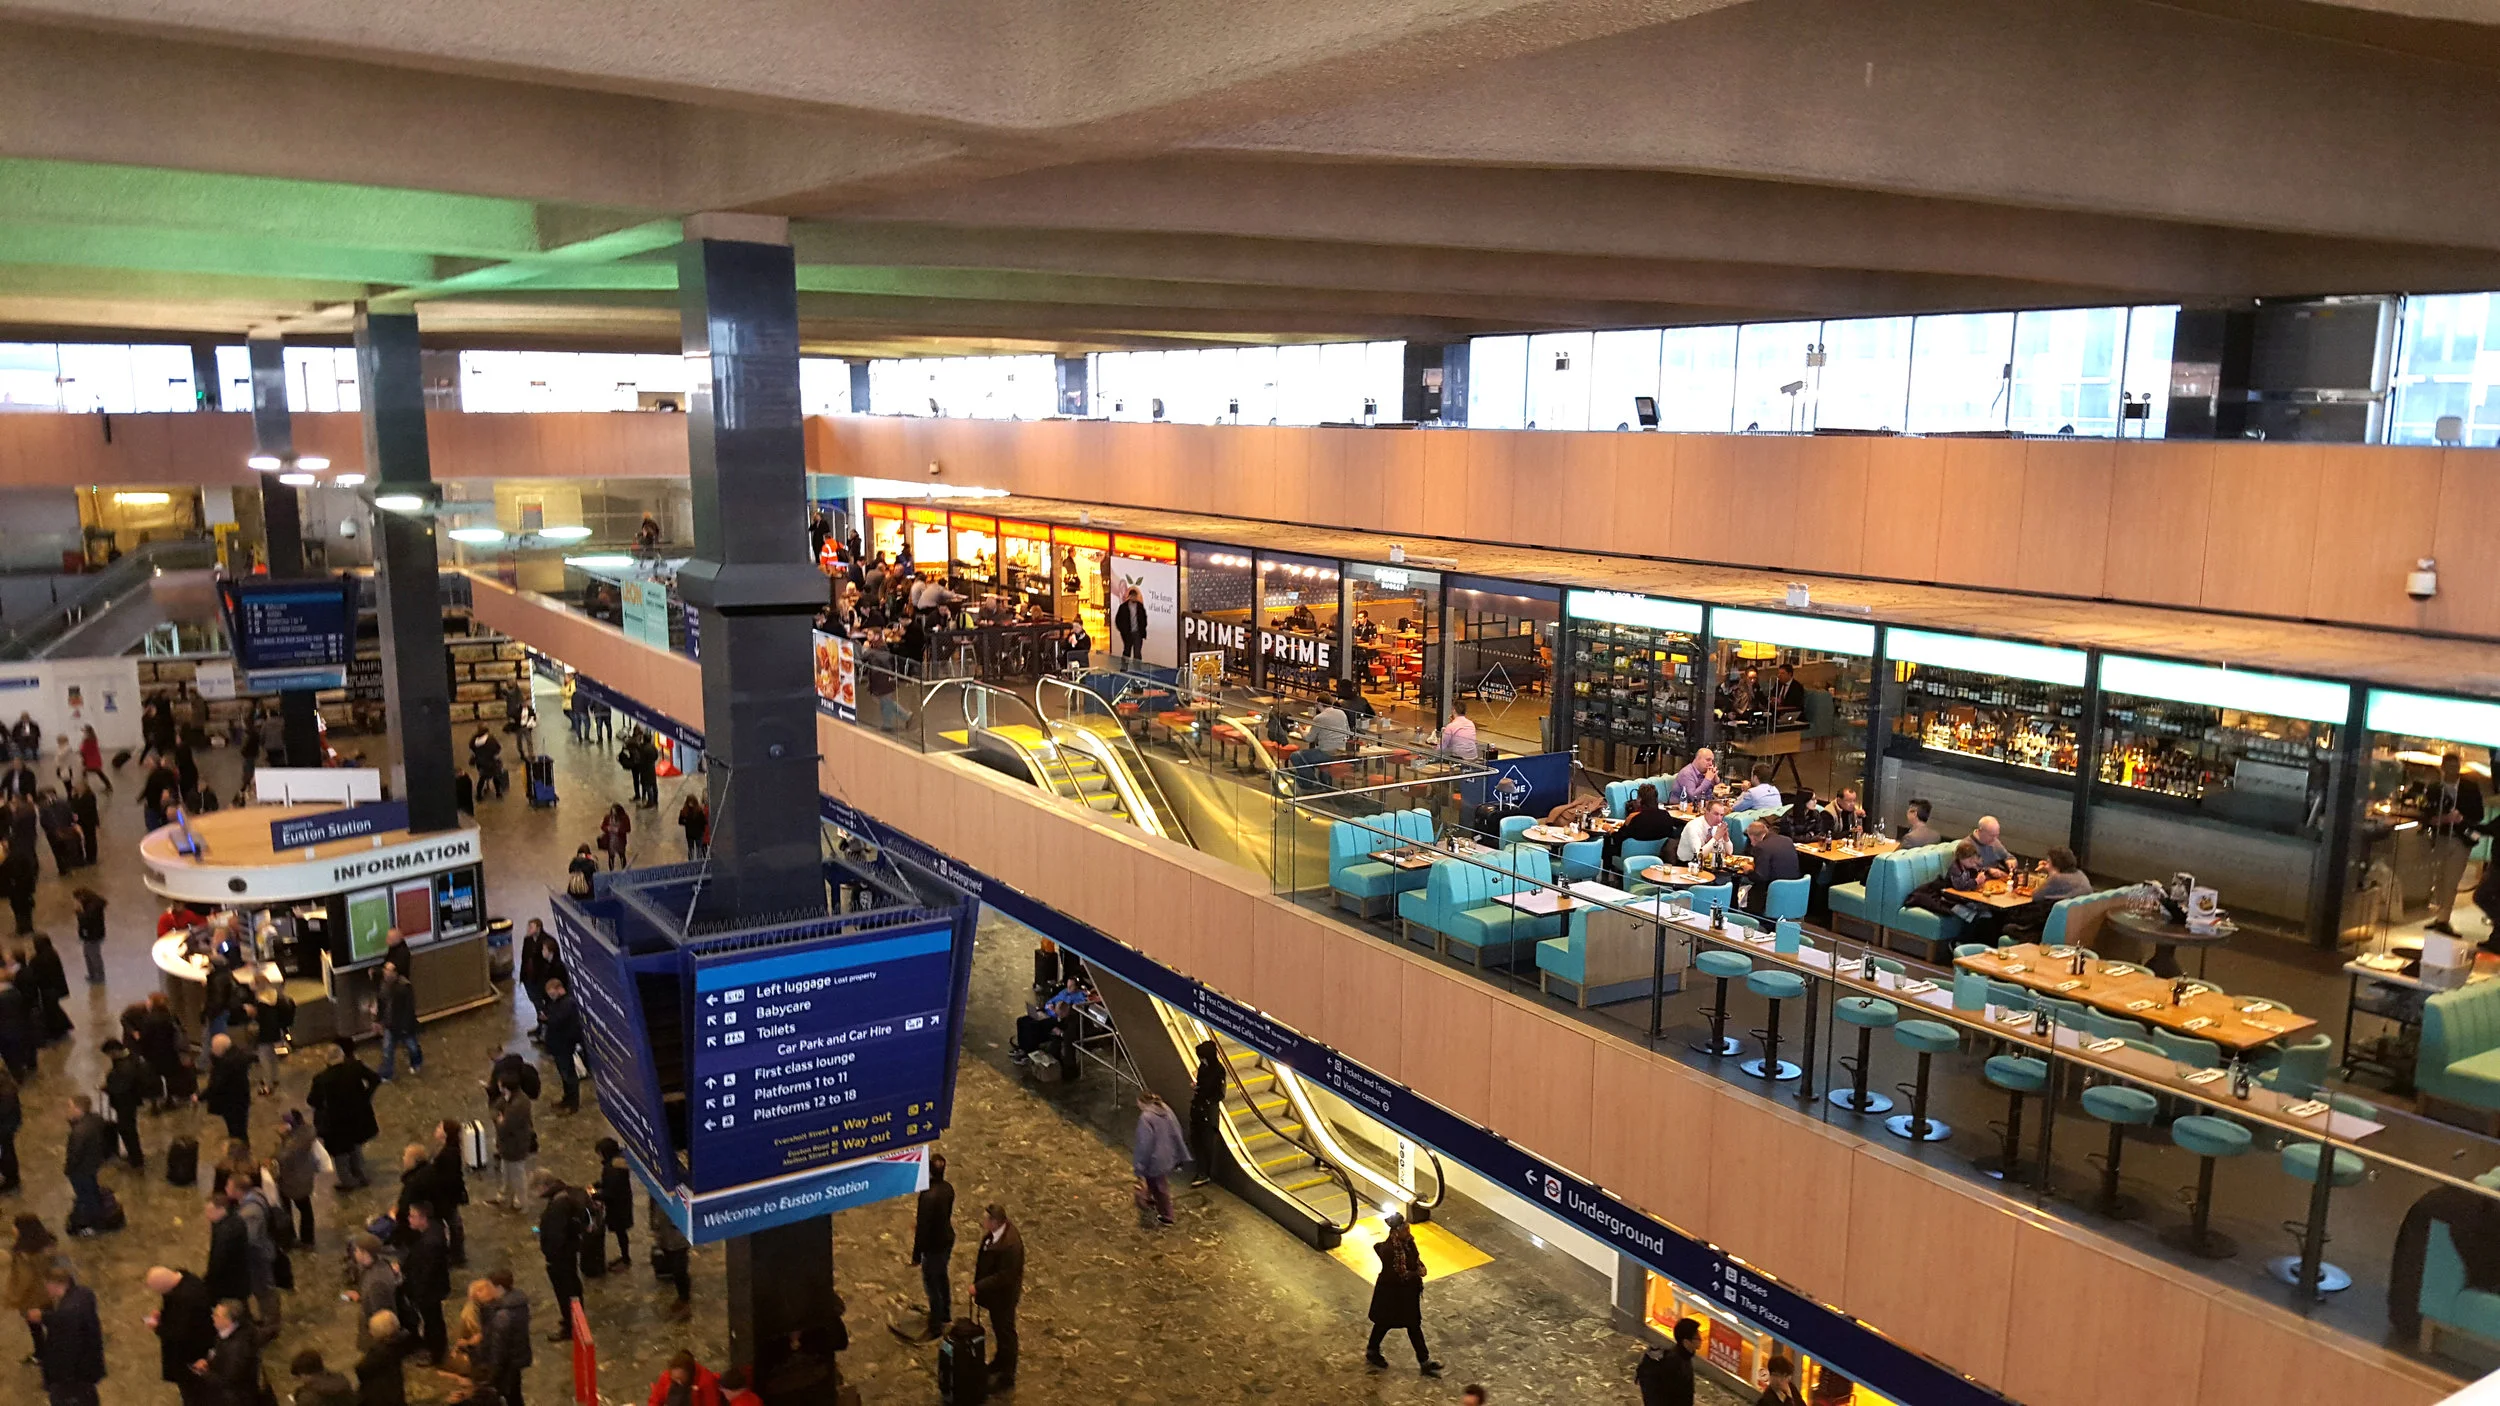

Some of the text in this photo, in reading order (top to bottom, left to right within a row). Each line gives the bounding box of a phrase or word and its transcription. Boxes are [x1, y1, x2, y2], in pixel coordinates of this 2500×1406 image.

[1184, 616, 1246, 650] PRIME
[1261, 631, 1330, 668] PRIME
[283, 820, 372, 846] Euston Station
[333, 840, 470, 883] INFORMATION
[756, 984, 781, 999] Left
[784, 975, 832, 994] luggage
[849, 970, 877, 984] property
[756, 1000, 812, 1019] Babycare
[1206, 994, 1216, 1006] First
[1216, 999, 1229, 1012] Class
[1229, 1005, 1246, 1022] lounge
[1206, 1008, 1232, 1029] Restaurants
[1231, 1022, 1241, 1034] and
[757, 1022, 796, 1039] Toilets
[777, 1024, 892, 1056] Car Park and Car Hire
[754, 1052, 856, 1080] First class lounge
[754, 1072, 848, 1101] Platforms 1 to 11
[1342, 1079, 1381, 1108] Visitor centre
[1344, 1064, 1392, 1098] Tickets and Trains
[753, 1089, 857, 1121] Platforms 12 to 18
[808, 1128, 830, 1138] Street
[842, 1116, 869, 1132] Way
[871, 1111, 892, 1124] out
[842, 1137, 868, 1152] Way
[870, 1130, 891, 1144] out
[703, 1178, 869, 1228] Welcome to Euston Station
[1567, 1190, 1664, 1256] Underground
[1740, 1275, 1769, 1298] Buses
[1740, 1295, 1791, 1330] The Piazza
